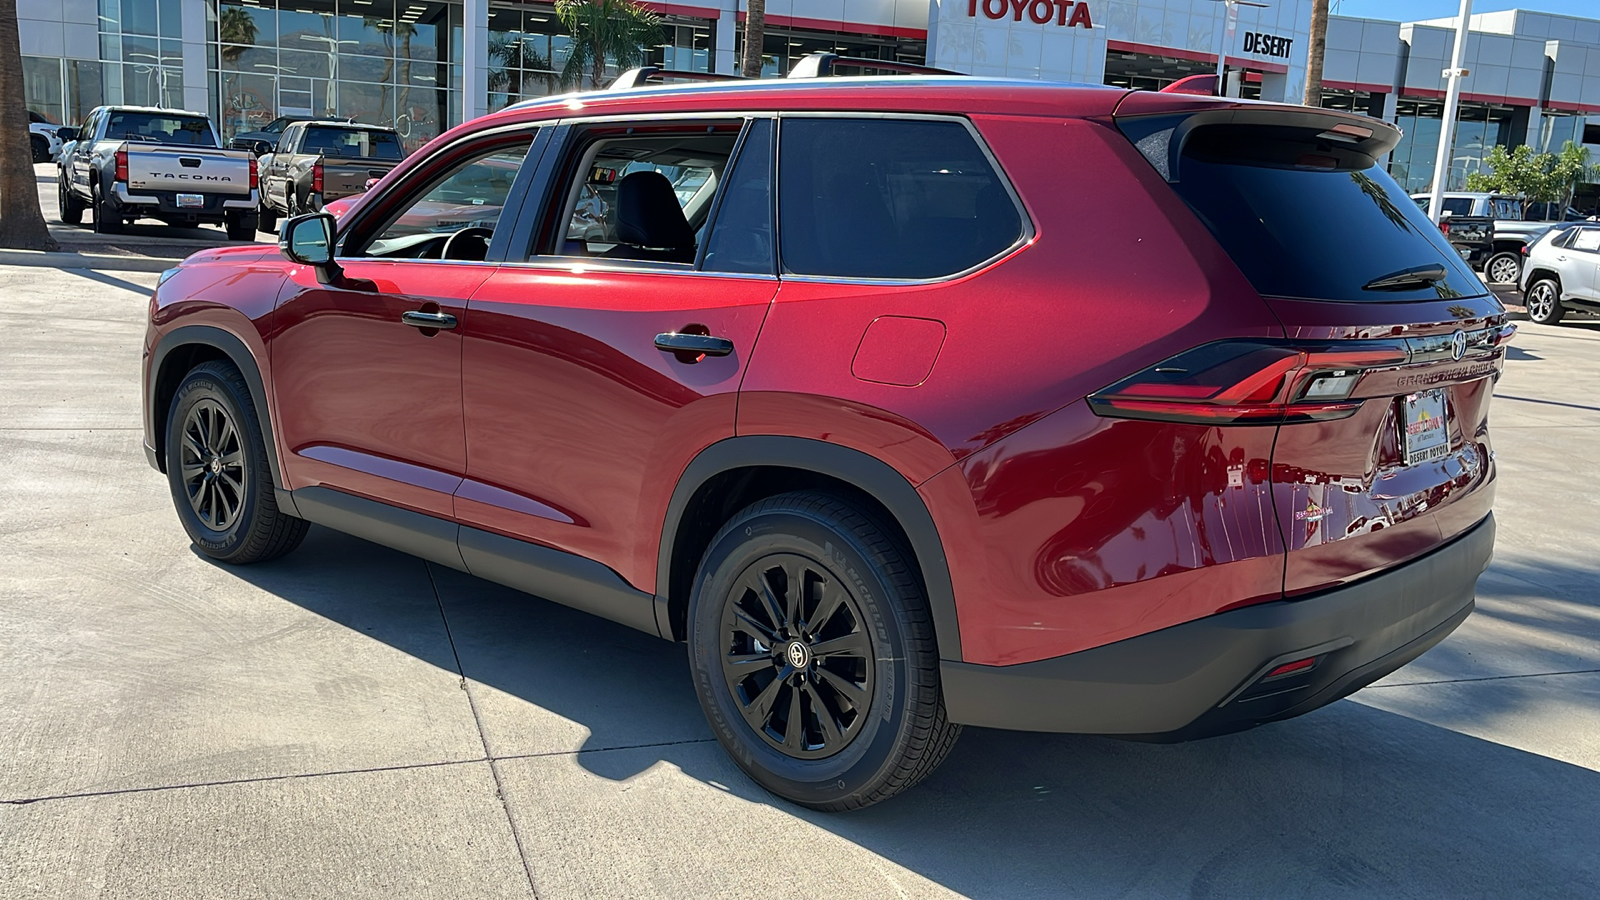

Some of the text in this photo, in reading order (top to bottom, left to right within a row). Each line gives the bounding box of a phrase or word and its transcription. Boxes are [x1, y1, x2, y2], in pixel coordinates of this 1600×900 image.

[1243, 31, 1293, 58] DESERT
[149, 172, 232, 182] TACOMA
[1409, 444, 1449, 465] DESERT TOYOTA
[848, 567, 888, 640] MICHELIN
[701, 672, 733, 739] MICHELIN
